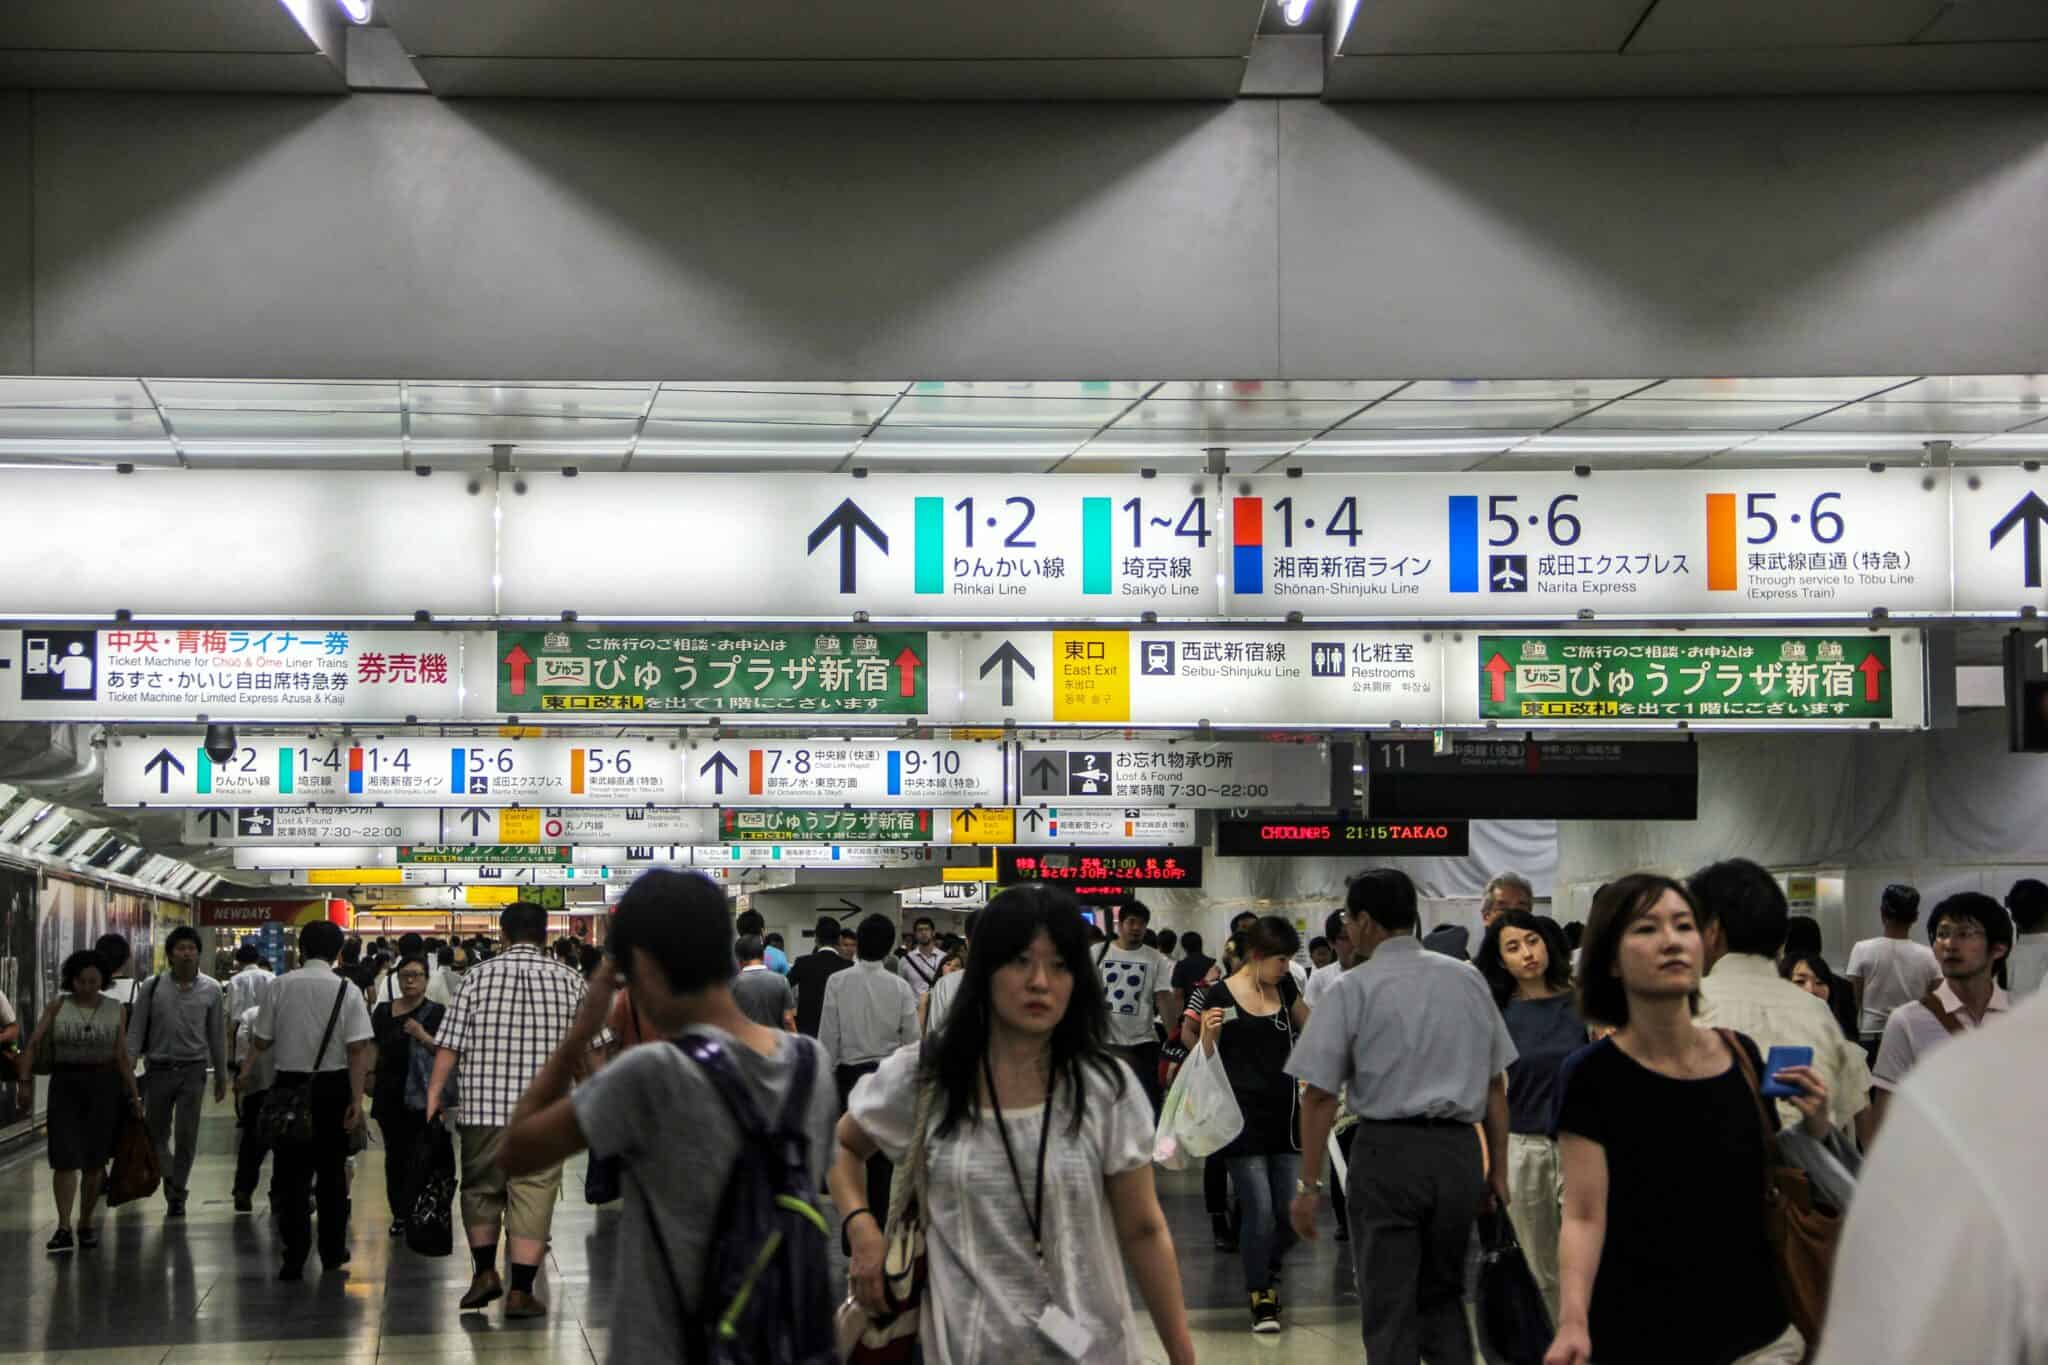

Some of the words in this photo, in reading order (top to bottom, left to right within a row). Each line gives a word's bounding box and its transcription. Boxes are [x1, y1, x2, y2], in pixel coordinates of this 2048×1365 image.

[954, 497, 1037, 548] 1・2
[1273, 497, 1363, 547] 1・4
[1488, 494, 1582, 546] 5・6
[1745, 492, 1845, 544] 5・6
[953, 556, 1065, 578] りんかい線
[1122, 556, 1192, 578] 埼京線
[1273, 556, 1432, 578] 湘南新宿ライン
[1537, 554, 1690, 576] 成田エクスプレス
[1748, 551, 1911, 571] 東武線直通（特急）
[953, 583, 995, 595] Rinkai
[999, 583, 1027, 595] Line
[1171, 583, 1200, 595] Line
[1391, 582, 1419, 594] Line
[1537, 581, 1578, 593] Narita
[1583, 581, 1637, 596] Express
[1748, 574, 1796, 587] Through
[1799, 575, 1840, 585] service
[1843, 574, 1855, 584] to
[1890, 574, 1914, 584] Line
[1747, 588, 1798, 600] (Express
[1803, 587, 1835, 599] Train)
[107, 631, 349, 655] 中央・青梅ライナー券
[586, 638, 787, 651] ご旅行のご相談・お申込は
[1064, 640, 1104, 660] 東口
[1182, 642, 1286, 663] 西武新宿線
[1352, 642, 1414, 663] 化粧室
[1562, 646, 1755, 658] ご旅行のご相談・お申込は
[108, 656, 142, 667] Ticket
[144, 656, 191, 667] Machine
[195, 656, 209, 667] for
[286, 657, 312, 668] Liner
[317, 657, 349, 669] Trains
[358, 652, 448, 684] 券売機
[1064, 664, 1090, 676] East
[1096, 664, 1117, 676] Exit
[107, 671, 349, 691] あずさ・かいじ自由席特急券
[594, 654, 890, 692] びゅうプラザ新宿
[1182, 666, 1272, 679] Seibu-Shinjuku
[1275, 667, 1300, 678] Line
[1352, 667, 1416, 678] Restrooms
[1569, 661, 1856, 697] びゅうプラザ新宿
[108, 692, 138, 703] Ticket
[140, 692, 182, 703] Machine
[185, 692, 198, 703] for
[200, 692, 236, 703] Limited
[239, 692, 278, 705] Express
[281, 693, 312, 704] Azusa
[314, 693, 321, 704] &
[368, 748, 411, 773] 1・4
[470, 748, 513, 773] 5・6
[589, 749, 632, 773] 5・6
[767, 750, 811, 774] 7・8
[905, 750, 960, 774] 9・10
[1116, 751, 1233, 768] お忘れ物承り所
[1381, 744, 1406, 768] 11
[216, 776, 270, 786] りんかい線
[493, 776, 563, 787] 成田エクスプレス
[1116, 771, 1137, 781] Lost
[1151, 771, 1183, 781] Found
[1116, 785, 1165, 797] 営業時間
[767, 811, 914, 830] びゅうプラザ新宿
[1346, 826, 1388, 839] 21:15
[1390, 826, 1448, 839] TAKAO
[901, 847, 924, 861] 5・6
[1104, 858, 1136, 868] 21:00
[213, 906, 272, 920] NEWDAYS
